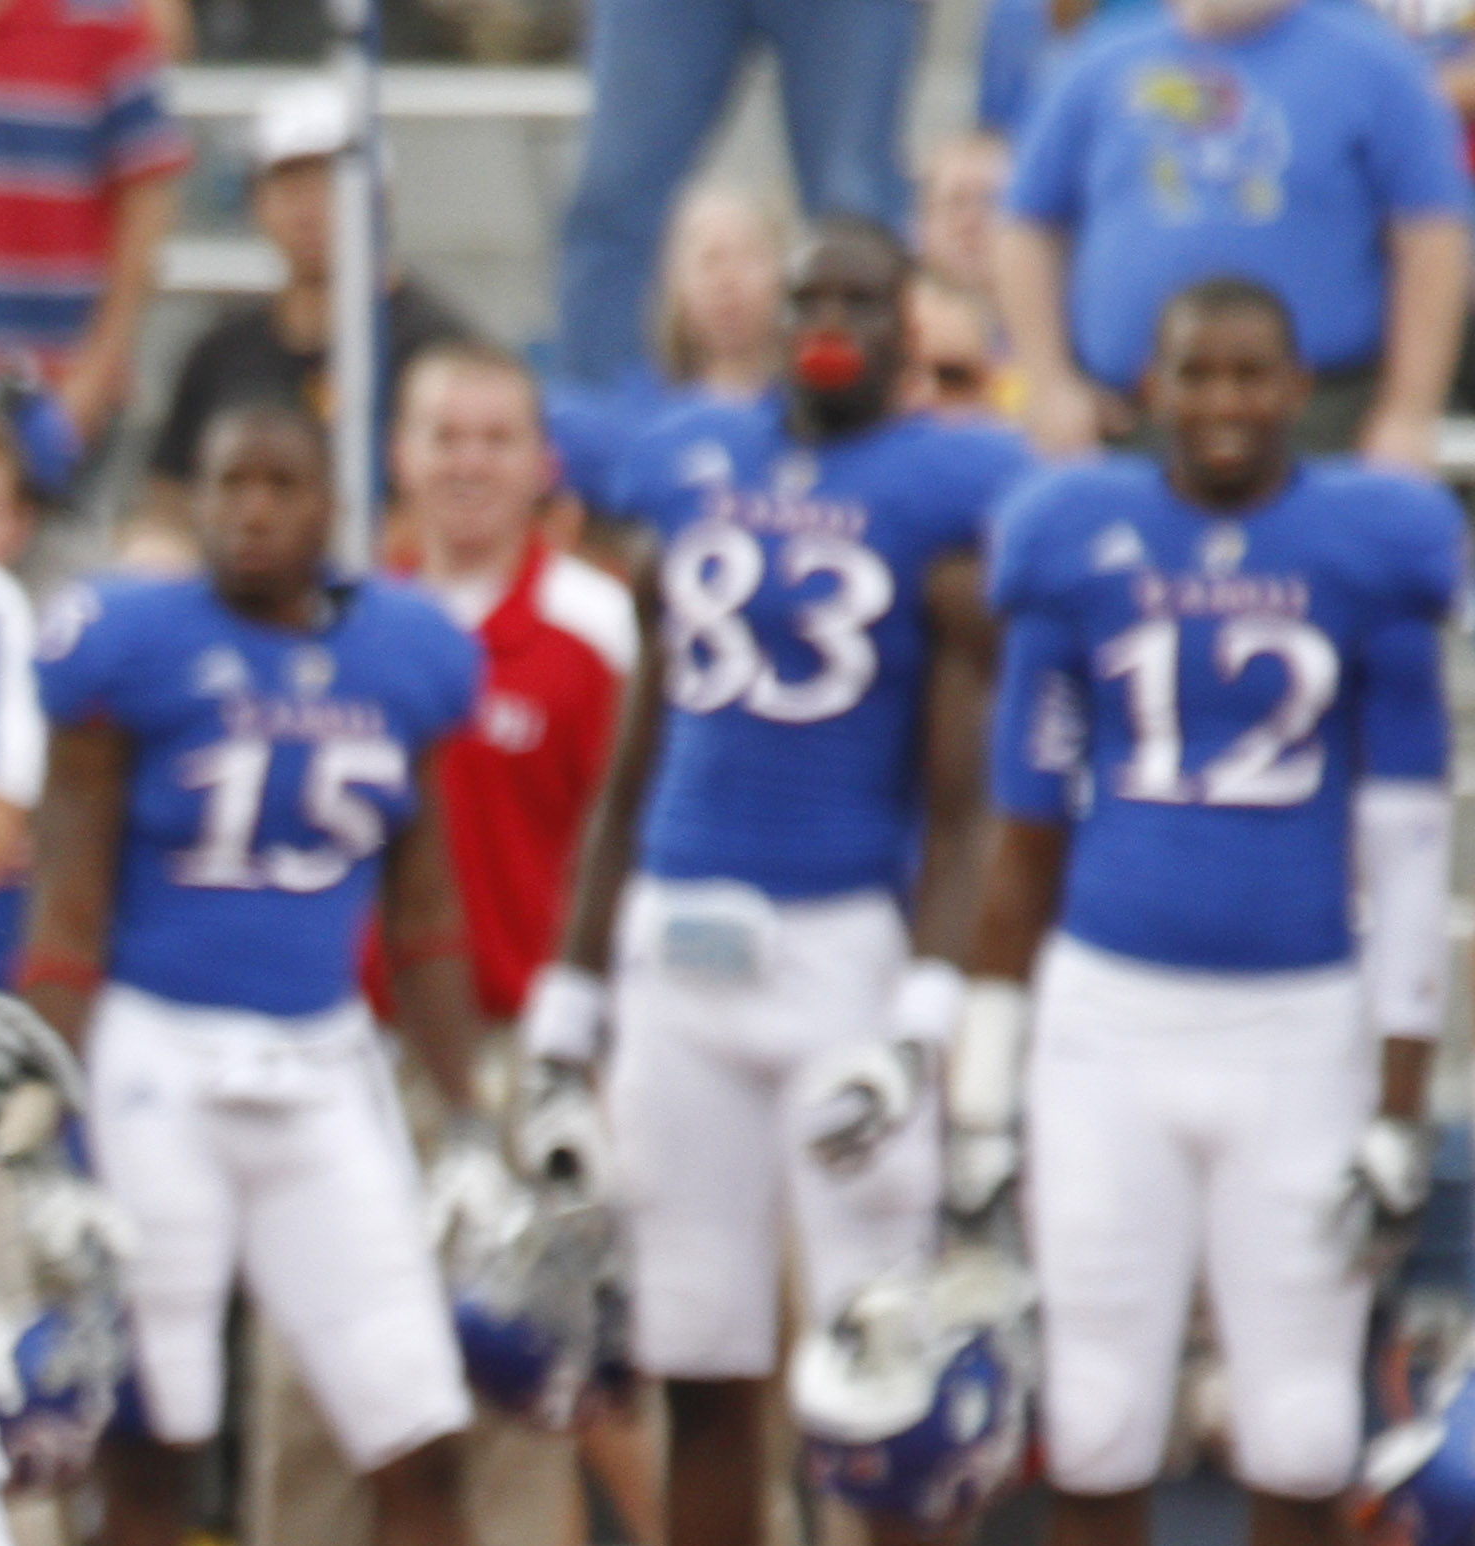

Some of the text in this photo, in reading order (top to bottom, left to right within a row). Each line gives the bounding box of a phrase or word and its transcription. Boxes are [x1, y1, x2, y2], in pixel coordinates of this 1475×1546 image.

[663, 518, 895, 724] 83
[1096, 615, 1343, 806] 12
[169, 739, 409, 894] 15
